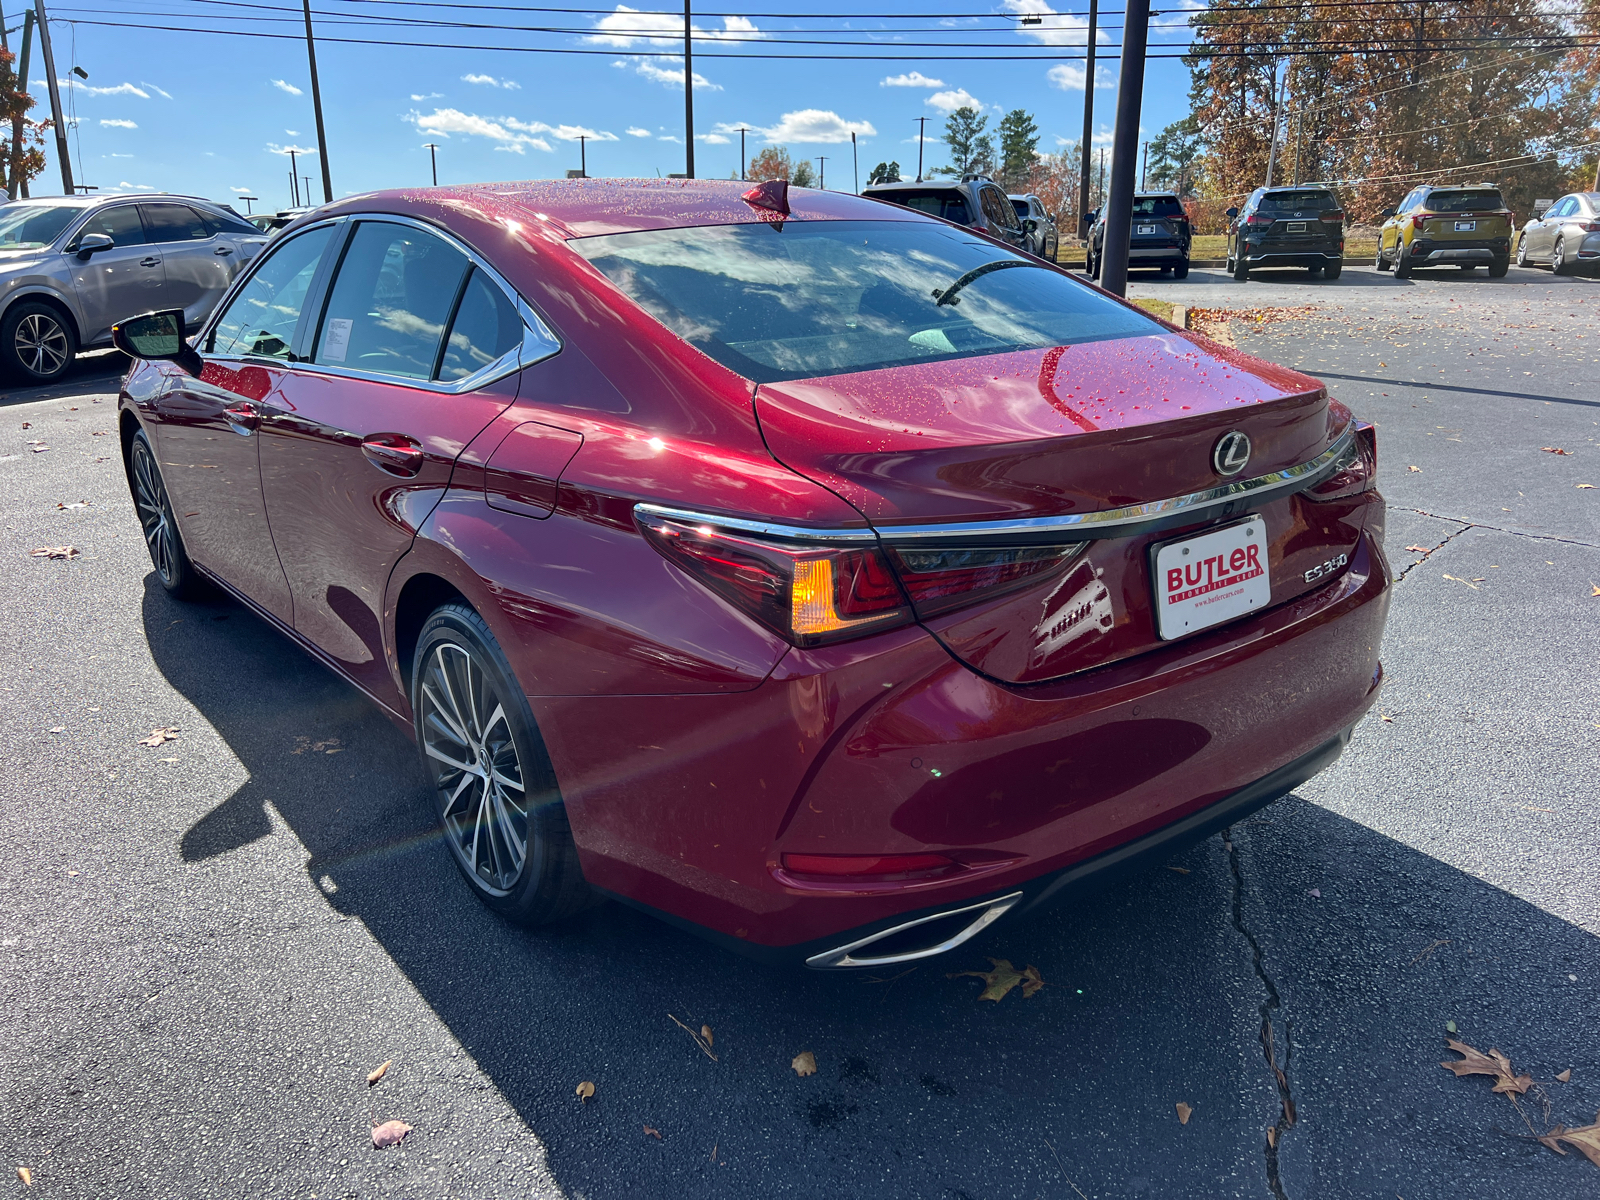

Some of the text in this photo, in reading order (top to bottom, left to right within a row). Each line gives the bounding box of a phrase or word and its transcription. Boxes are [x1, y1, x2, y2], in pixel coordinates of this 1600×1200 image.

[1169, 568, 1262, 604] AUTOMOTIVE GROUP
[1194, 587, 1245, 608] www.butlercars.com
